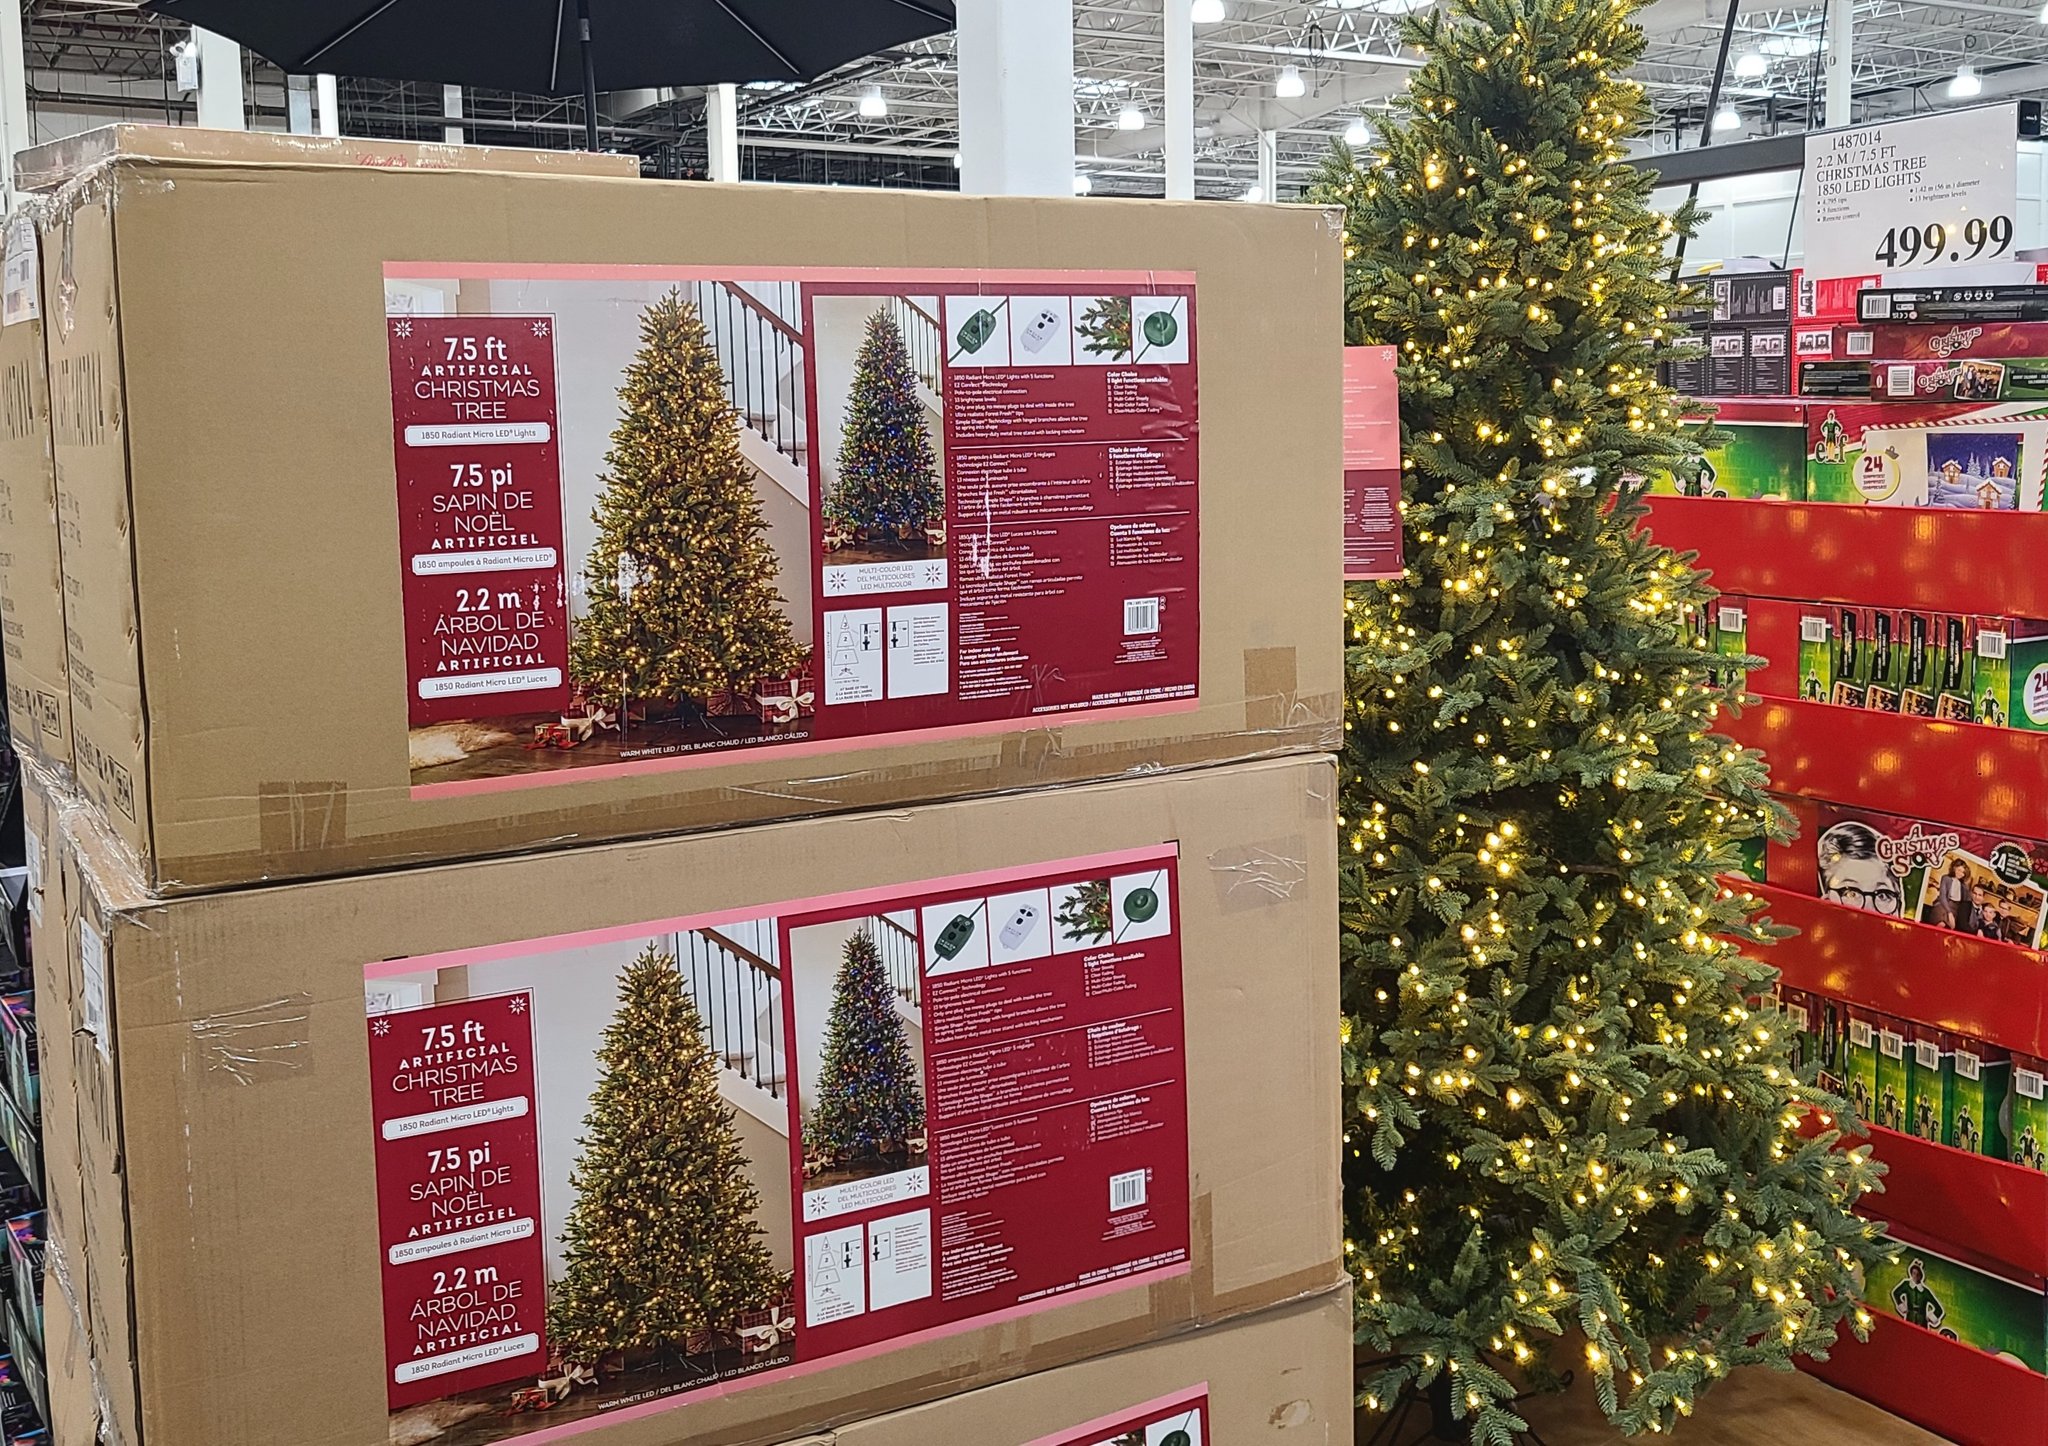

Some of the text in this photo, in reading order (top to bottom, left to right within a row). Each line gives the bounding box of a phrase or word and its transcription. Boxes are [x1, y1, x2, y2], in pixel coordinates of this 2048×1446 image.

[1831, 130, 1882, 150] 1487014
[1816, 146, 1896, 169] 2.2 M / 7.5 FT
[1817, 156, 1927, 182] CHRISTMAS TREE
[1817, 171, 1921, 196] 1850 LED LIGHTS
[1875, 215, 2013, 268] 499.99
[444, 337, 507, 360] 7.5 ft
[421, 364, 532, 376] ARTIFICIAL
[415, 380, 540, 398] CHRISTMAS
[452, 402, 507, 419] TREE
[1864, 456, 1883, 472] 24
[450, 463, 512, 492] 7.5 pi
[433, 492, 533, 512] SAPIN DE
[455, 512, 515, 533] NOËL
[432, 534, 539, 549] ARTIFICIEL
[438, 559, 474, 568] ampoules
[870, 573, 915, 581] MULTICOLORES
[874, 581, 911, 589] MULTICOLOR
[456, 588, 521, 612] 2.2 m
[434, 611, 545, 635] ÁRBOL DE
[442, 633, 538, 656] NAVIDAD
[437, 653, 545, 672] ARTIFICIAL
[435, 683, 453, 691] 1850
[455, 681, 484, 689] Radiant
[486, 679, 506, 687] Micro
[527, 675, 547, 683] Luces
[620, 750, 640, 758] WARM
[694, 742, 715, 750] BLANC
[717, 739, 739, 748] CHAUD
[757, 735, 783, 743] BLANCO
[784, 731, 808, 739] CÁLIDO
[1906, 826, 1920, 840] A
[1878, 835, 1957, 859] CHRISTMAS
[1893, 851, 1948, 874] STORY
[1990, 851, 2006, 872] 24
[422, 1020, 485, 1050] 7.5 ft
[399, 1042, 510, 1070] ARTIFICIAL
[392, 1055, 518, 1092] CHRISTMAS
[429, 1082, 484, 1107] TREE
[399, 1122, 418, 1131] 1850
[420, 1117, 449, 1128] Radiant
[451, 1113, 471, 1122] Micro
[492, 1105, 514, 1116] Lights
[428, 1141, 490, 1173] 7.5 pi
[410, 1166, 511, 1200] SAPIN DE
[840, 1181, 884, 1194] MULTI-COLOR
[850, 1186, 897, 1200] MULTICOLORES
[432, 1191, 492, 1218] NOËL
[854, 1193, 893, 1206] MULTICOLOR
[408, 1207, 516, 1238] ARTIFICIEL
[395, 1248, 413, 1258] 1850
[415, 1242, 452, 1254] ampoules
[460, 1232, 489, 1244] Radiant
[491, 1229, 511, 1238] Micro
[433, 1266, 498, 1295] 2.2 m
[410, 1281, 522, 1321] ÁRBOL DE
[418, 1303, 516, 1340] NAVIDAD
[413, 1322, 522, 1355] ARTIFICIAL
[411, 1364, 430, 1374] 1850
[432, 1358, 461, 1369] Radiant
[463, 1354, 483, 1363] Micro
[504, 1342, 524, 1352] Luces
[598, 1400, 619, 1410] WARM
[620, 1395, 641, 1404] WHITE
[642, 1390, 654, 1399] LED
[673, 1380, 695, 1391] BLANC
[696, 1373, 718, 1384] CHAUD
[725, 1369, 736, 1377] LED
[738, 1363, 764, 1375] BLANCO
[765, 1355, 790, 1367] CÁLIDO
